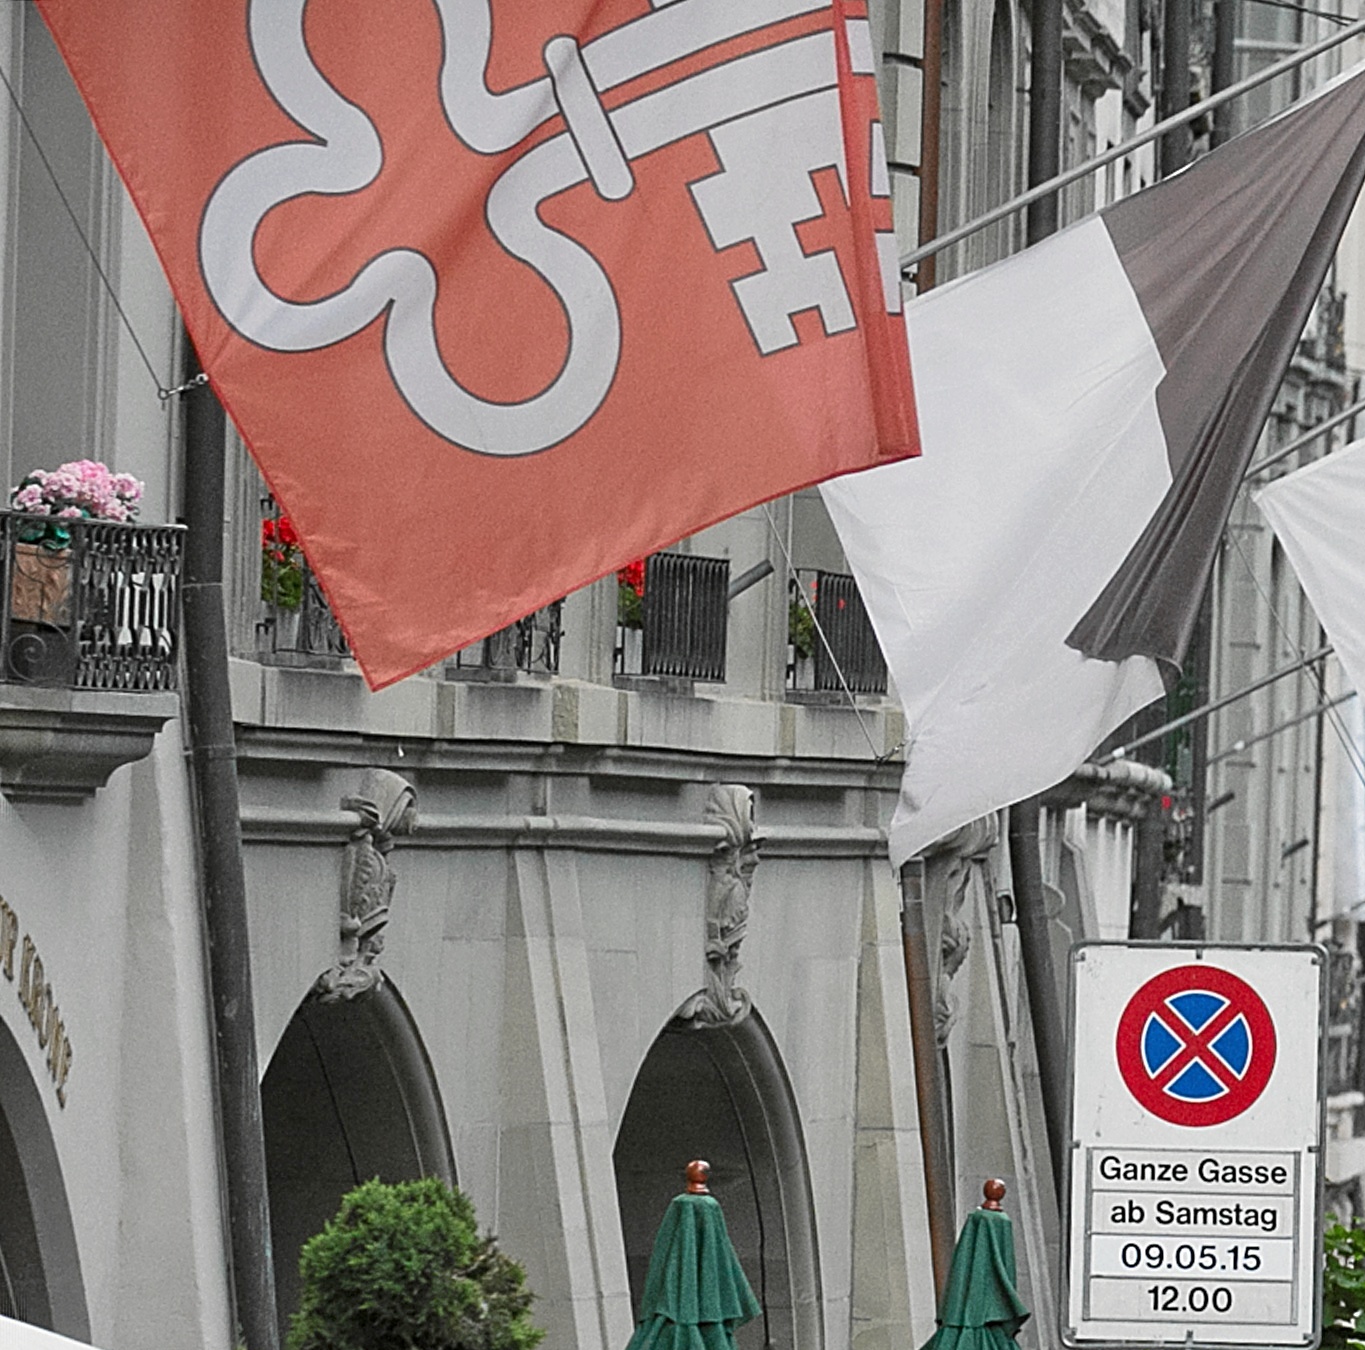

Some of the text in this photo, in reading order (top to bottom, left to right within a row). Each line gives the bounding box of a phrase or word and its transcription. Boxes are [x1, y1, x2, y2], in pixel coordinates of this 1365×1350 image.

[1100, 1156, 1288, 1184] Ganze Gasse
[1110, 1200, 1278, 1232] ab Samstag
[1121, 1243, 1262, 1271] 09.05.15
[1148, 1285, 1233, 1313] 12.00
